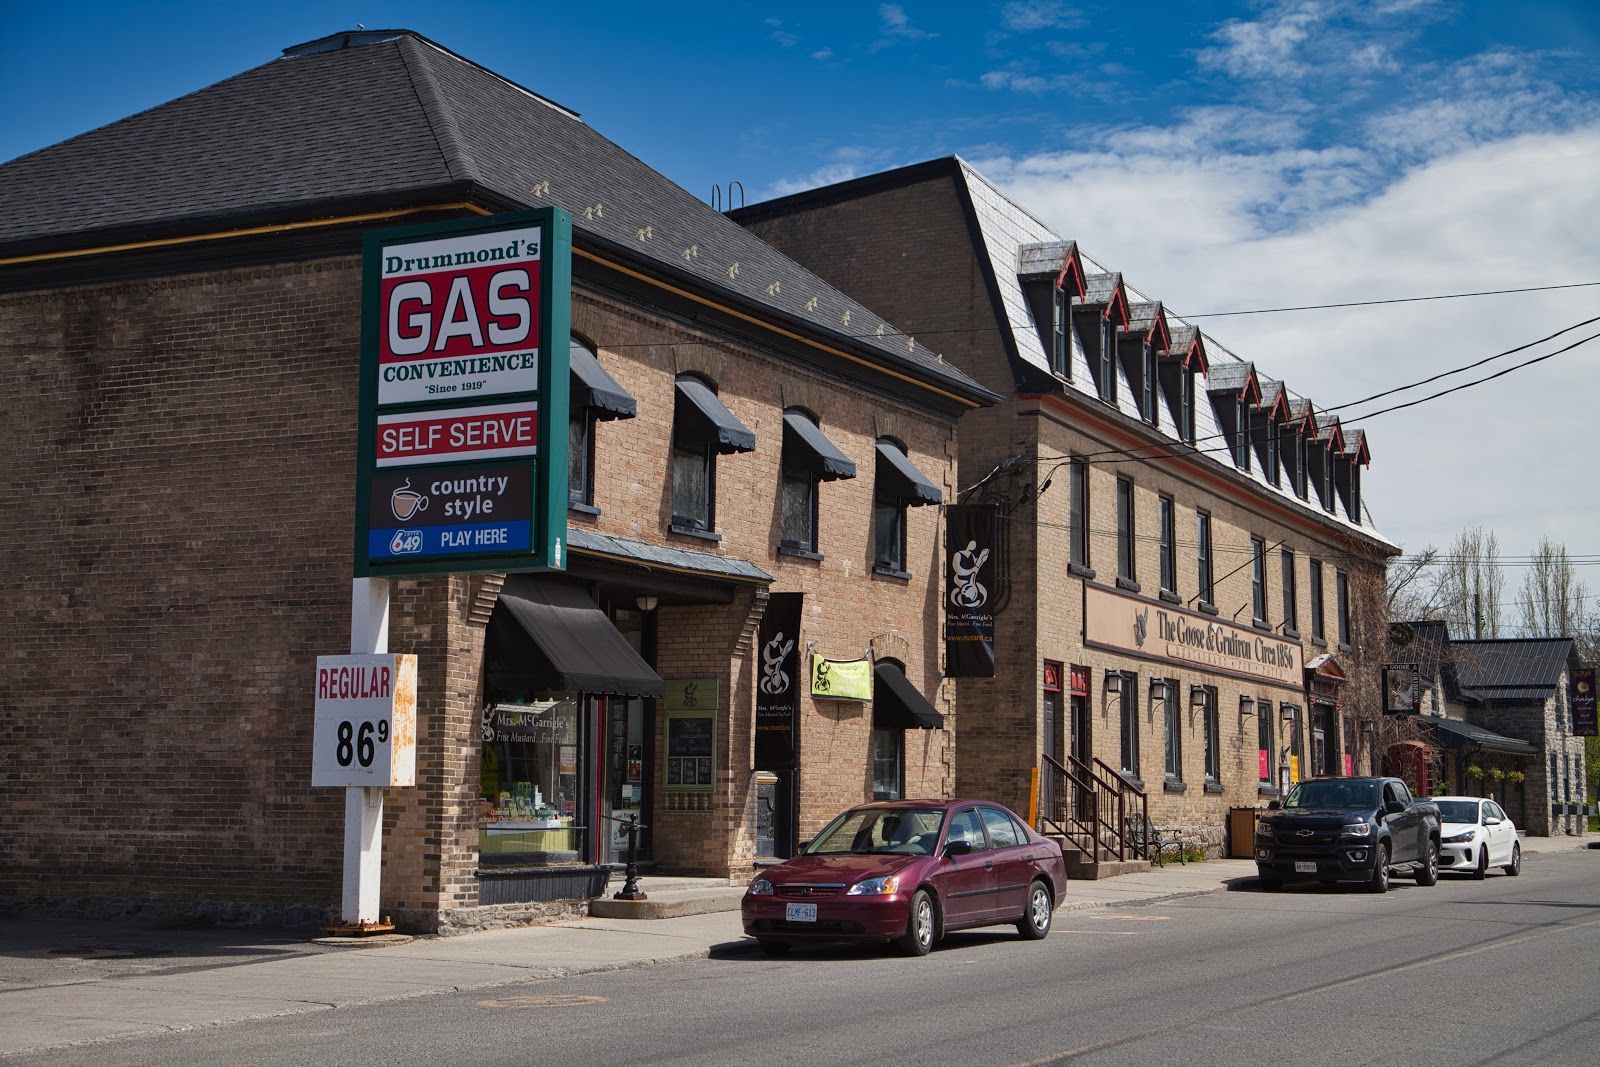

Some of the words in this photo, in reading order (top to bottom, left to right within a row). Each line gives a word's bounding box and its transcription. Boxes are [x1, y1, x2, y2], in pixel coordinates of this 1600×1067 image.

[385, 239, 539, 274] Drummond's
[388, 268, 532, 357] GAS
[383, 353, 534, 382] CONVENIENCE
[382, 425, 442, 453] SELF
[449, 417, 532, 447] SERVE
[430, 475, 509, 496] country
[444, 495, 493, 520] style
[441, 530, 472, 547] PLAY
[475, 528, 508, 545] HERE
[1157, 610, 1176, 639] The
[1177, 616, 1205, 646] Goose
[1206, 623, 1215, 651] &
[1216, 628, 1251, 661] Gridiron
[1255, 637, 1276, 666] Circa
[1276, 645, 1293, 669] 1856
[319, 666, 390, 699] REGULAR
[497, 713, 516, 726] Mrs.
[496, 731, 509, 742] Fine
